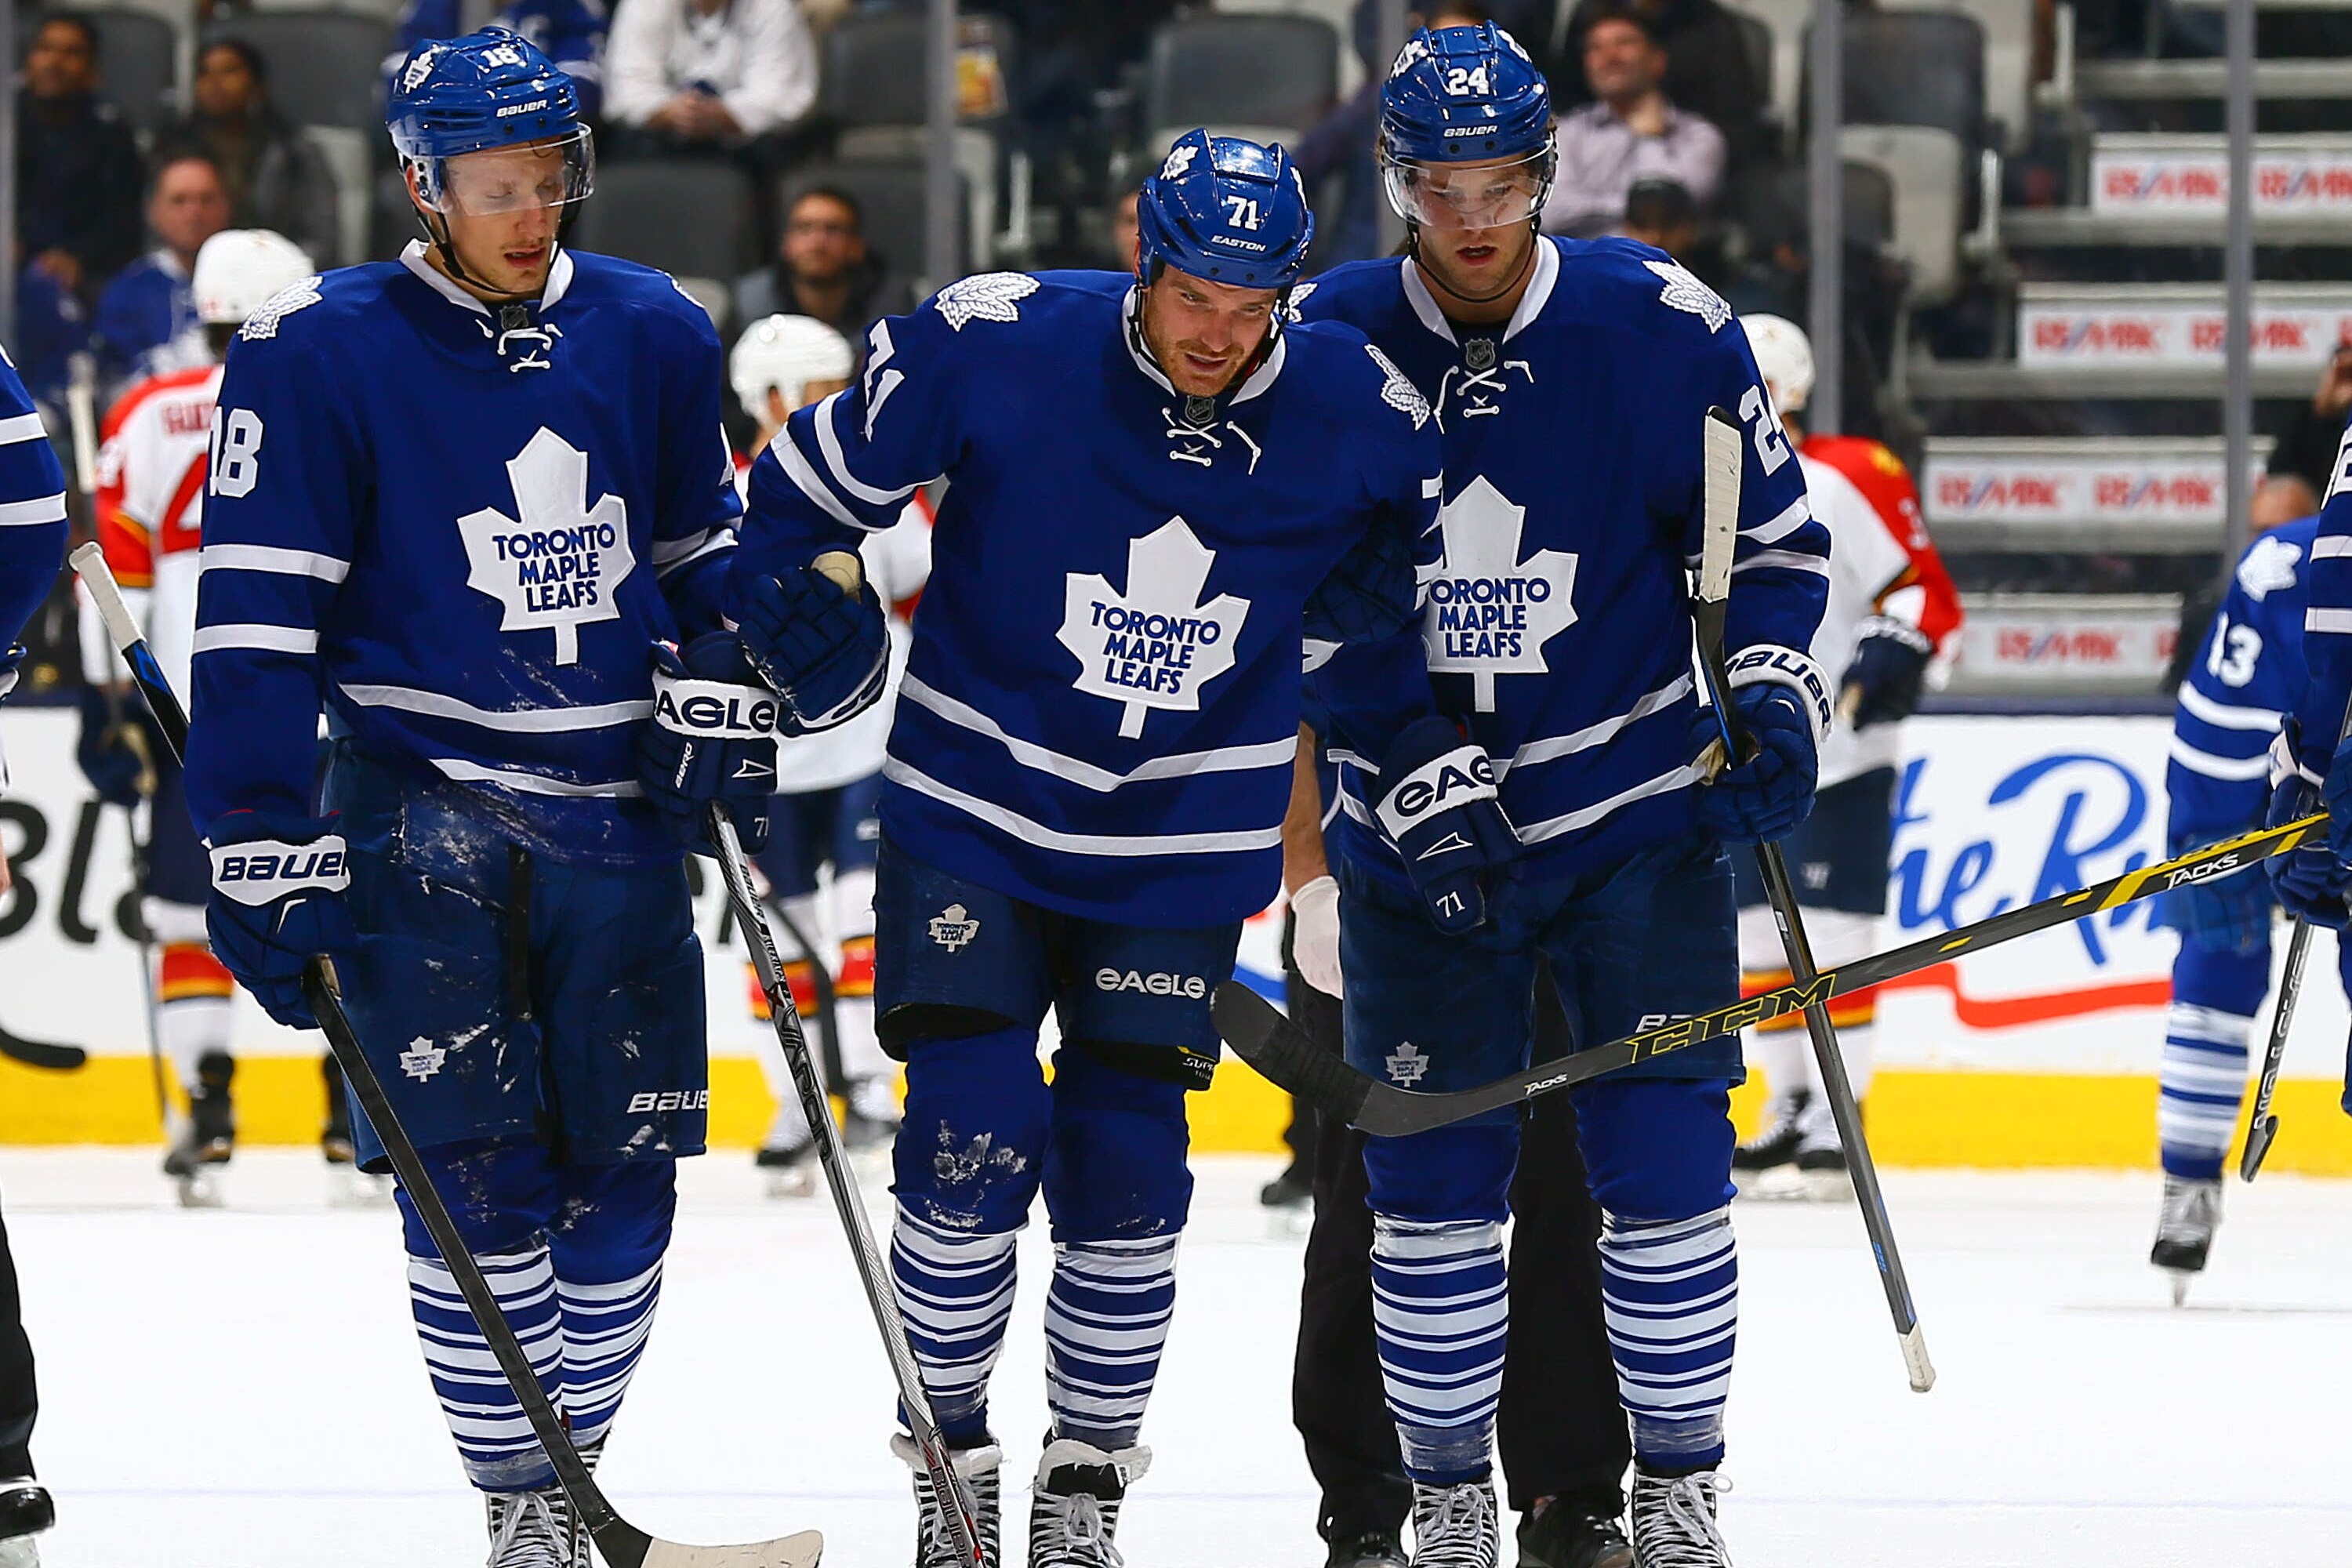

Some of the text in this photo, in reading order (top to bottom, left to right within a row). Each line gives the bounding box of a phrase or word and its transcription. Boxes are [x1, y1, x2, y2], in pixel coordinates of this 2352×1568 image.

[480, 47, 521, 67] 18
[1448, 67, 1490, 96] 24
[496, 100, 547, 118] BAUER
[1443, 125, 1498, 137] BAUER
[1227, 195, 1258, 230] 71
[1211, 234, 1267, 252] EASTON
[864, 318, 906, 443] 71
[492, 523, 616, 561] TORONTO
[518, 551, 601, 586] MAPLE
[526, 579, 598, 612] LEAFS
[1429, 576, 1552, 604] ORONTO
[1091, 601, 1221, 645] TORONTO
[1437, 604, 1527, 631] MAPLE
[1103, 632, 1195, 669] MAPLE
[1445, 632, 1522, 658] LEAFS
[2206, 612, 2263, 688] 13
[1105, 658, 1184, 695] LEAFS
[219, 852, 346, 882] BAUE
[2164, 853, 2239, 891] TACKS
[1436, 891, 1465, 918] 71
[1624, 973, 1836, 1064] CCM
[1523, 1073, 1568, 1096] TACKS
